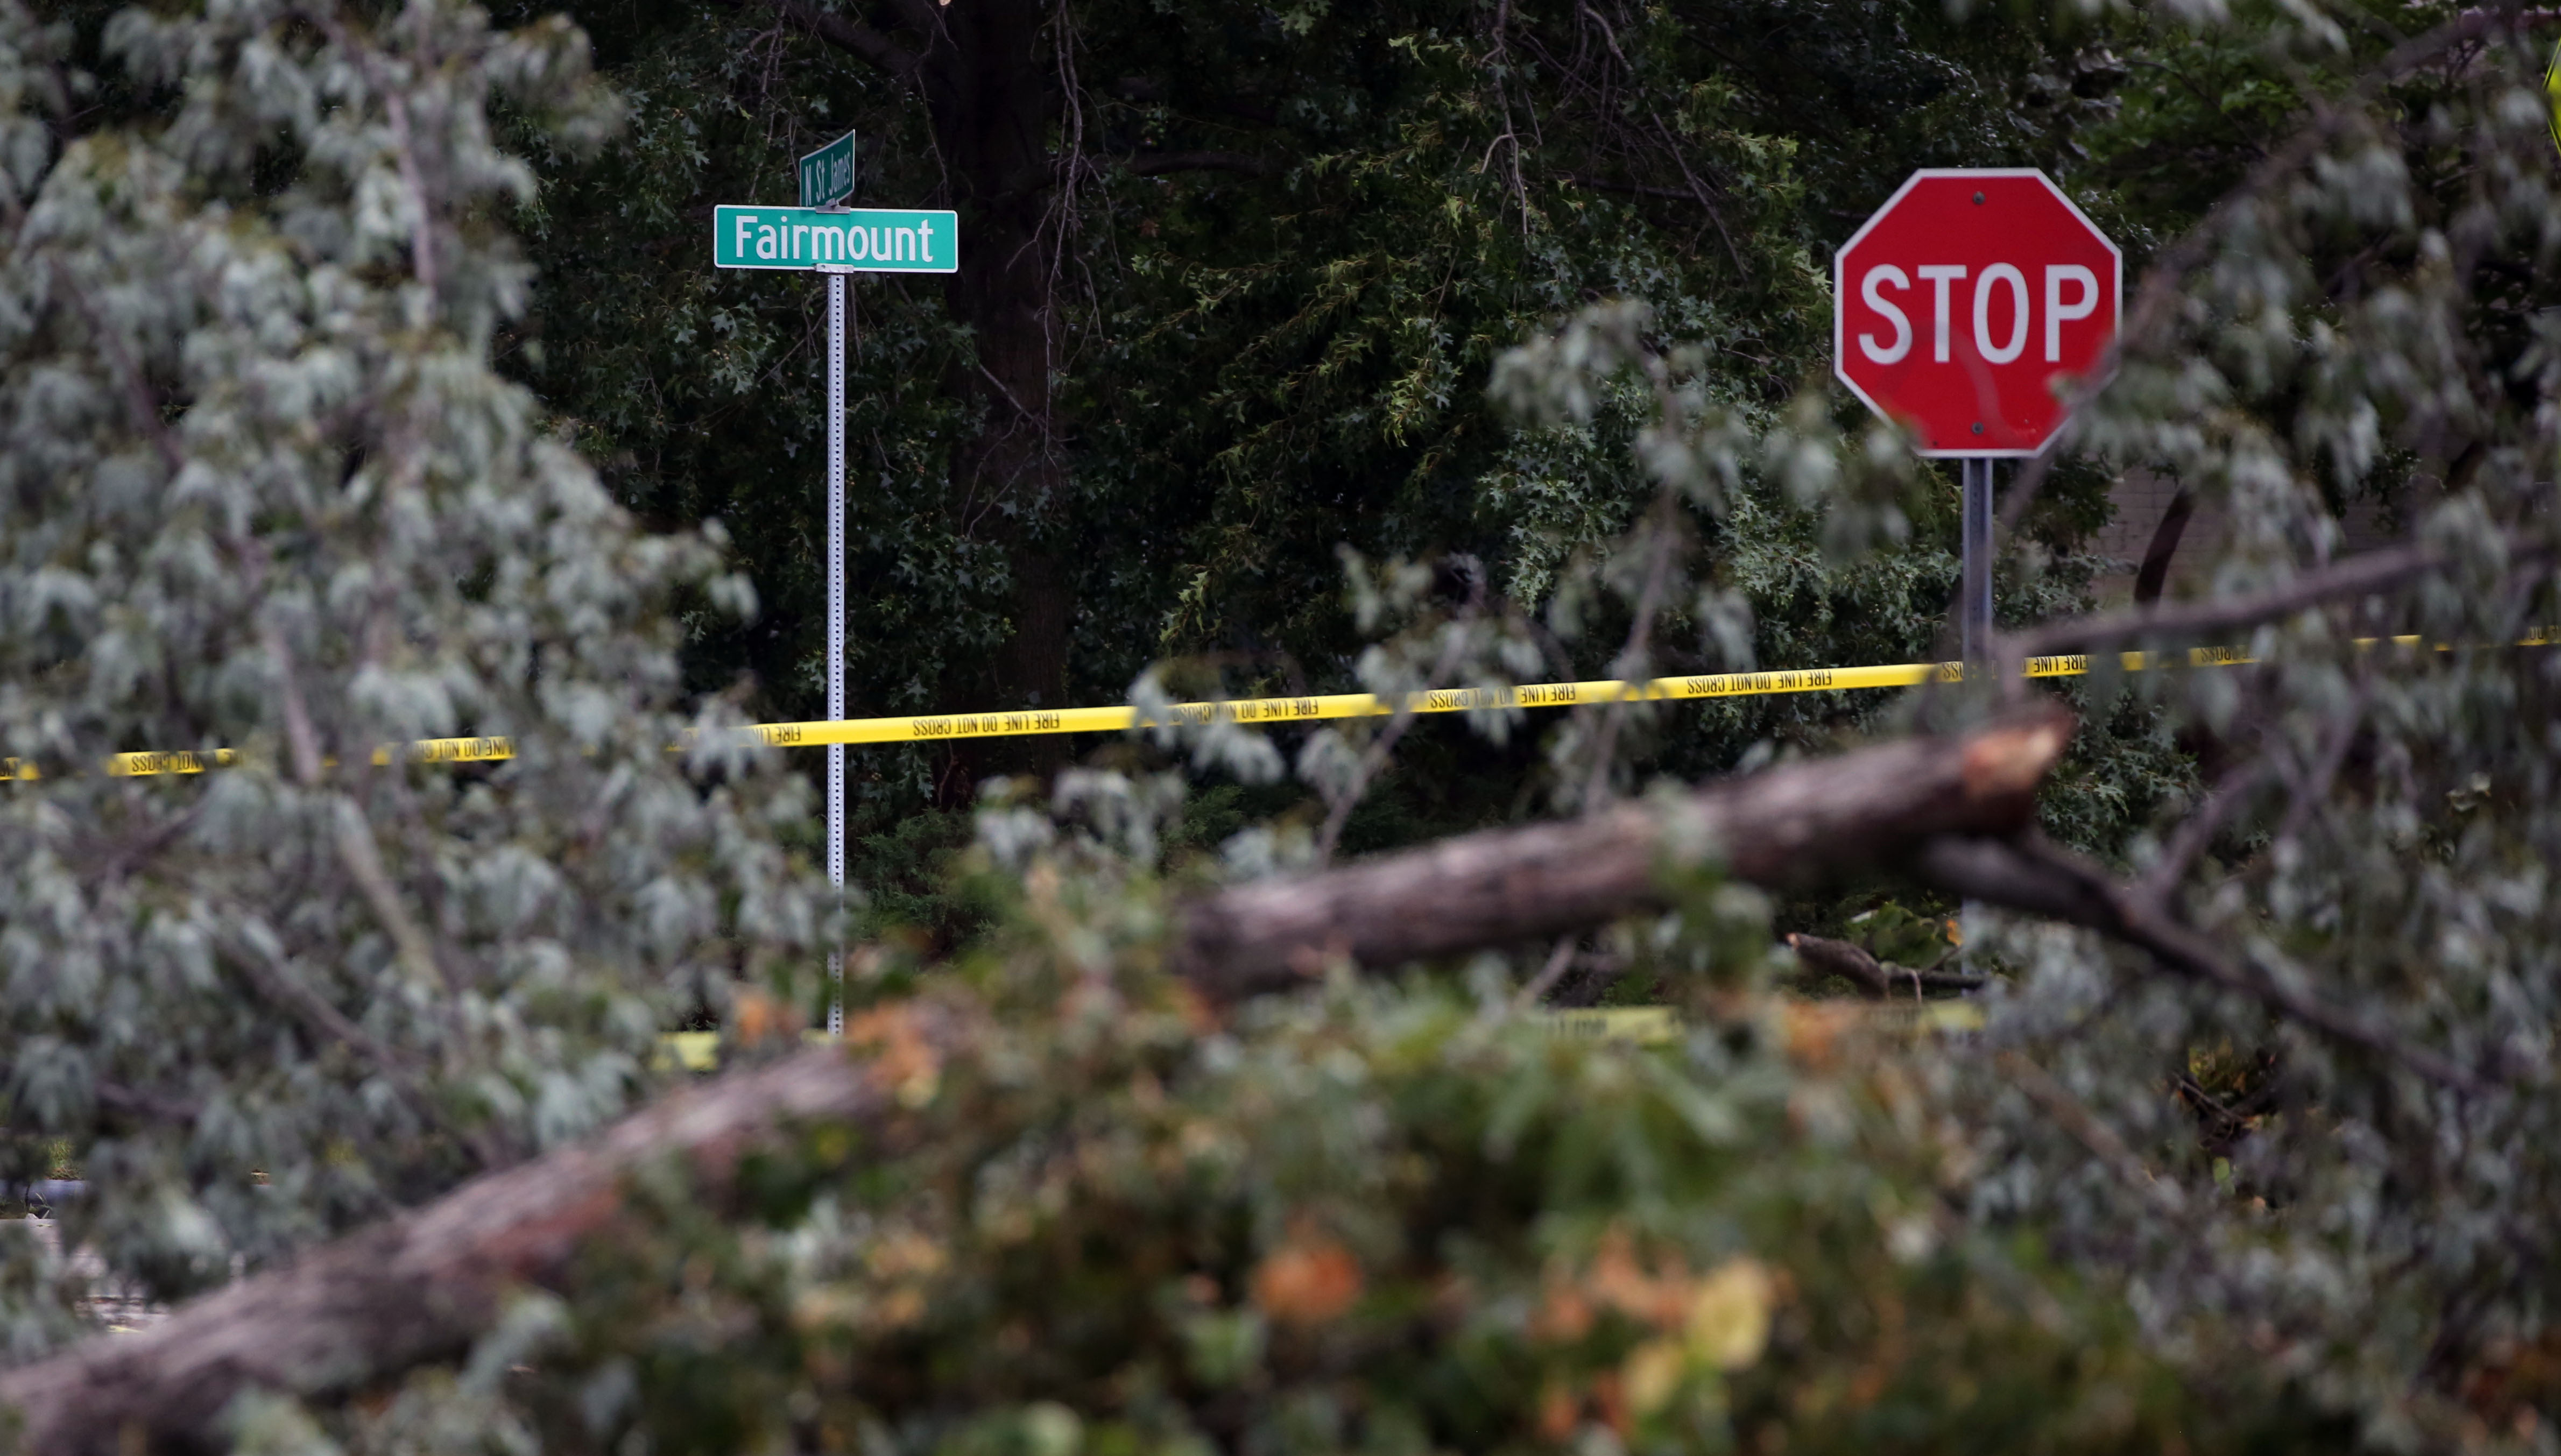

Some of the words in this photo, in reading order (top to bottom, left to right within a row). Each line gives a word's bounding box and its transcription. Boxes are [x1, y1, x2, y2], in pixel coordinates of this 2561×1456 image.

[806, 165, 811, 206] N
[816, 159, 825, 202] St
[829, 151, 850, 195] James
[736, 215, 934, 263] Fairmount
[1859, 262, 2099, 365] STOP
[2034, 657, 2058, 673] LINE
[2064, 655, 2089, 670] FIRE
[1687, 677, 1725, 694] CROSS
[1730, 675, 1752, 691] NOT
[1756, 674, 1770, 690] DO
[1778, 672, 1802, 689] LINE
[1807, 670, 1832, 687] FIRE
[1430, 691, 1469, 708] CROSS
[1521, 687, 1546, 703] LINE
[1551, 684, 1576, 701] FIRE
[1241, 703, 1256, 719] DO
[1263, 701, 1288, 718] LINE
[1293, 699, 1318, 716] FIRE
[913, 718, 951, 736] CROSS
[957, 717, 978, 734] NOT
[983, 715, 998, 732] DO
[1004, 713, 1029, 731] LINE
[1034, 712, 1060, 730] FIRE
[775, 726, 801, 743] FIRE
[464, 740, 481, 757] DO
